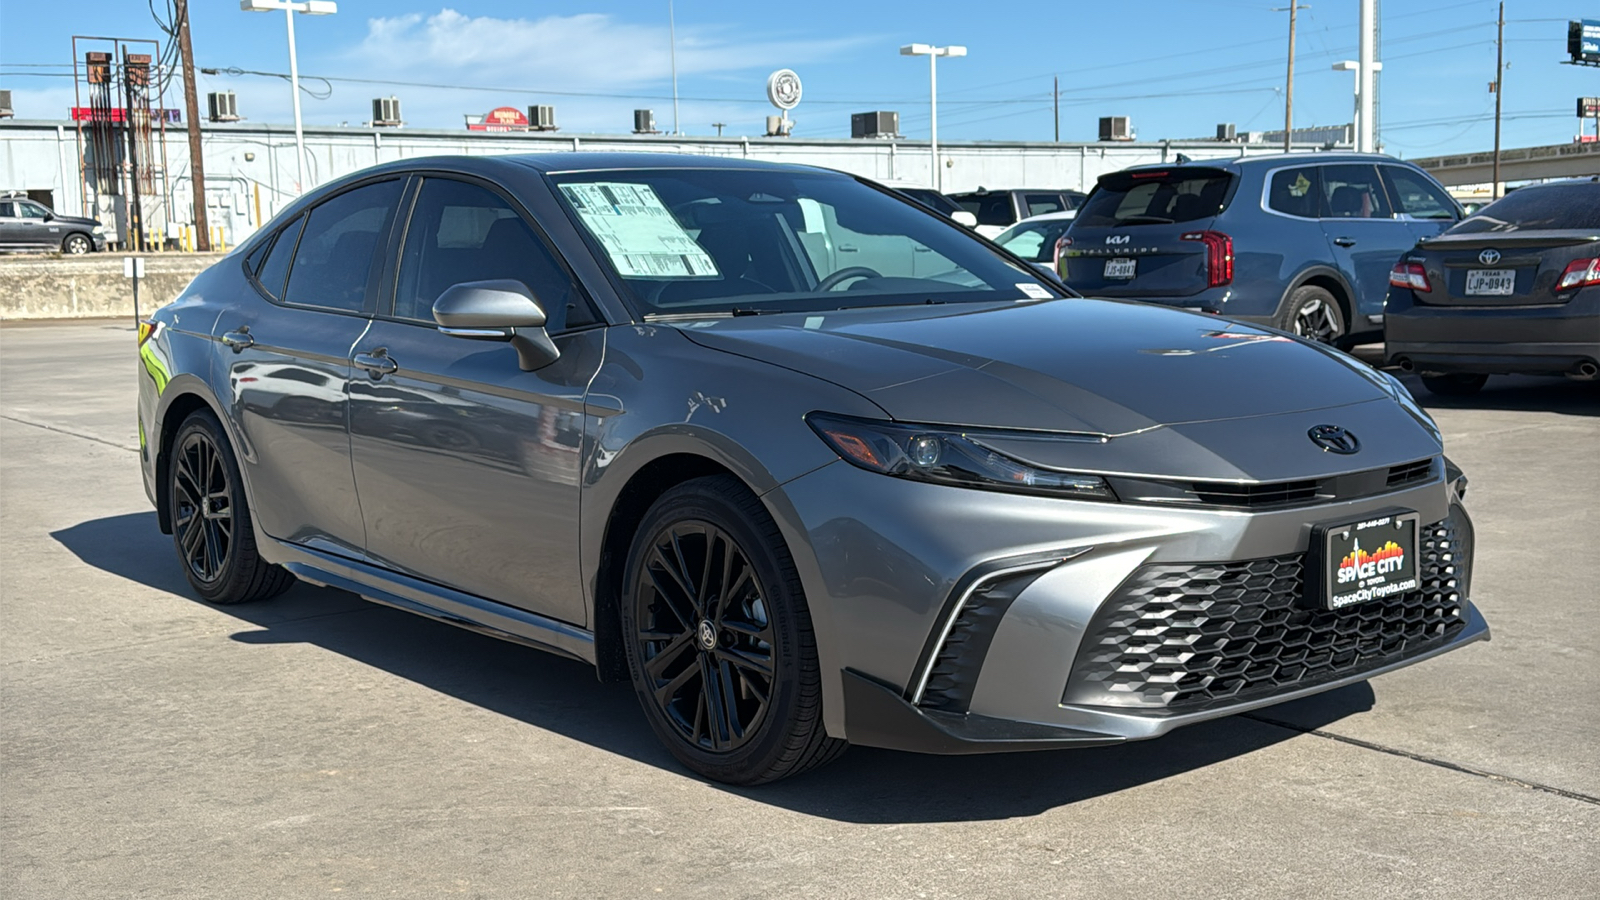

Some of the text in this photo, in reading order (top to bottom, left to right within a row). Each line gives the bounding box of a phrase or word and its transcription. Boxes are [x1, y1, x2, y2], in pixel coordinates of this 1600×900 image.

[1337, 555, 1404, 583] SPACE CITY
[1366, 575, 1386, 586] TOYOTA
[1332, 579, 1416, 607] SpaceCityToyota.com
